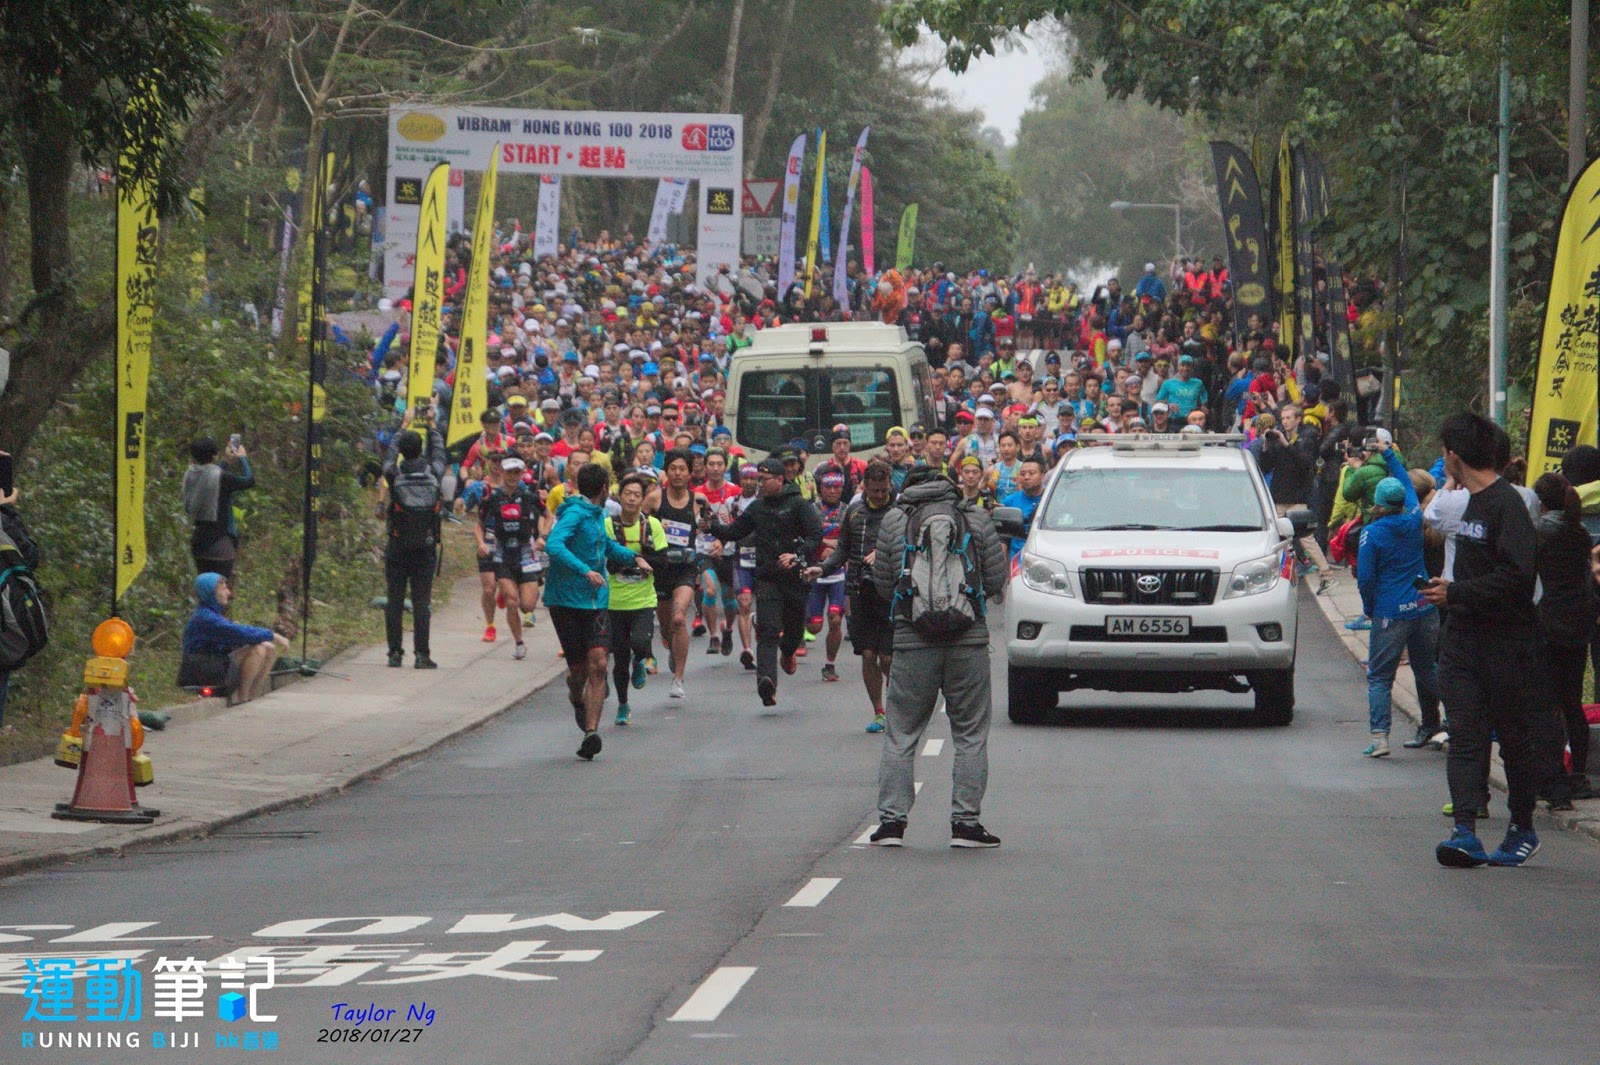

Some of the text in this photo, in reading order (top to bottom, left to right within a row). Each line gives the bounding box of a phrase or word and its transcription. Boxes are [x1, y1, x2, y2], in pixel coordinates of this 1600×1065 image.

[522, 119, 560, 135] HONG
[563, 121, 601, 136] KONG
[608, 123, 633, 138] 100
[639, 123, 673, 139] 2018
[711, 127, 731, 138] HK
[709, 137, 734, 148] 100
[503, 143, 562, 165] START
[579, 144, 626, 169] 起點
[1112, 619, 1184, 634] AM 6556
